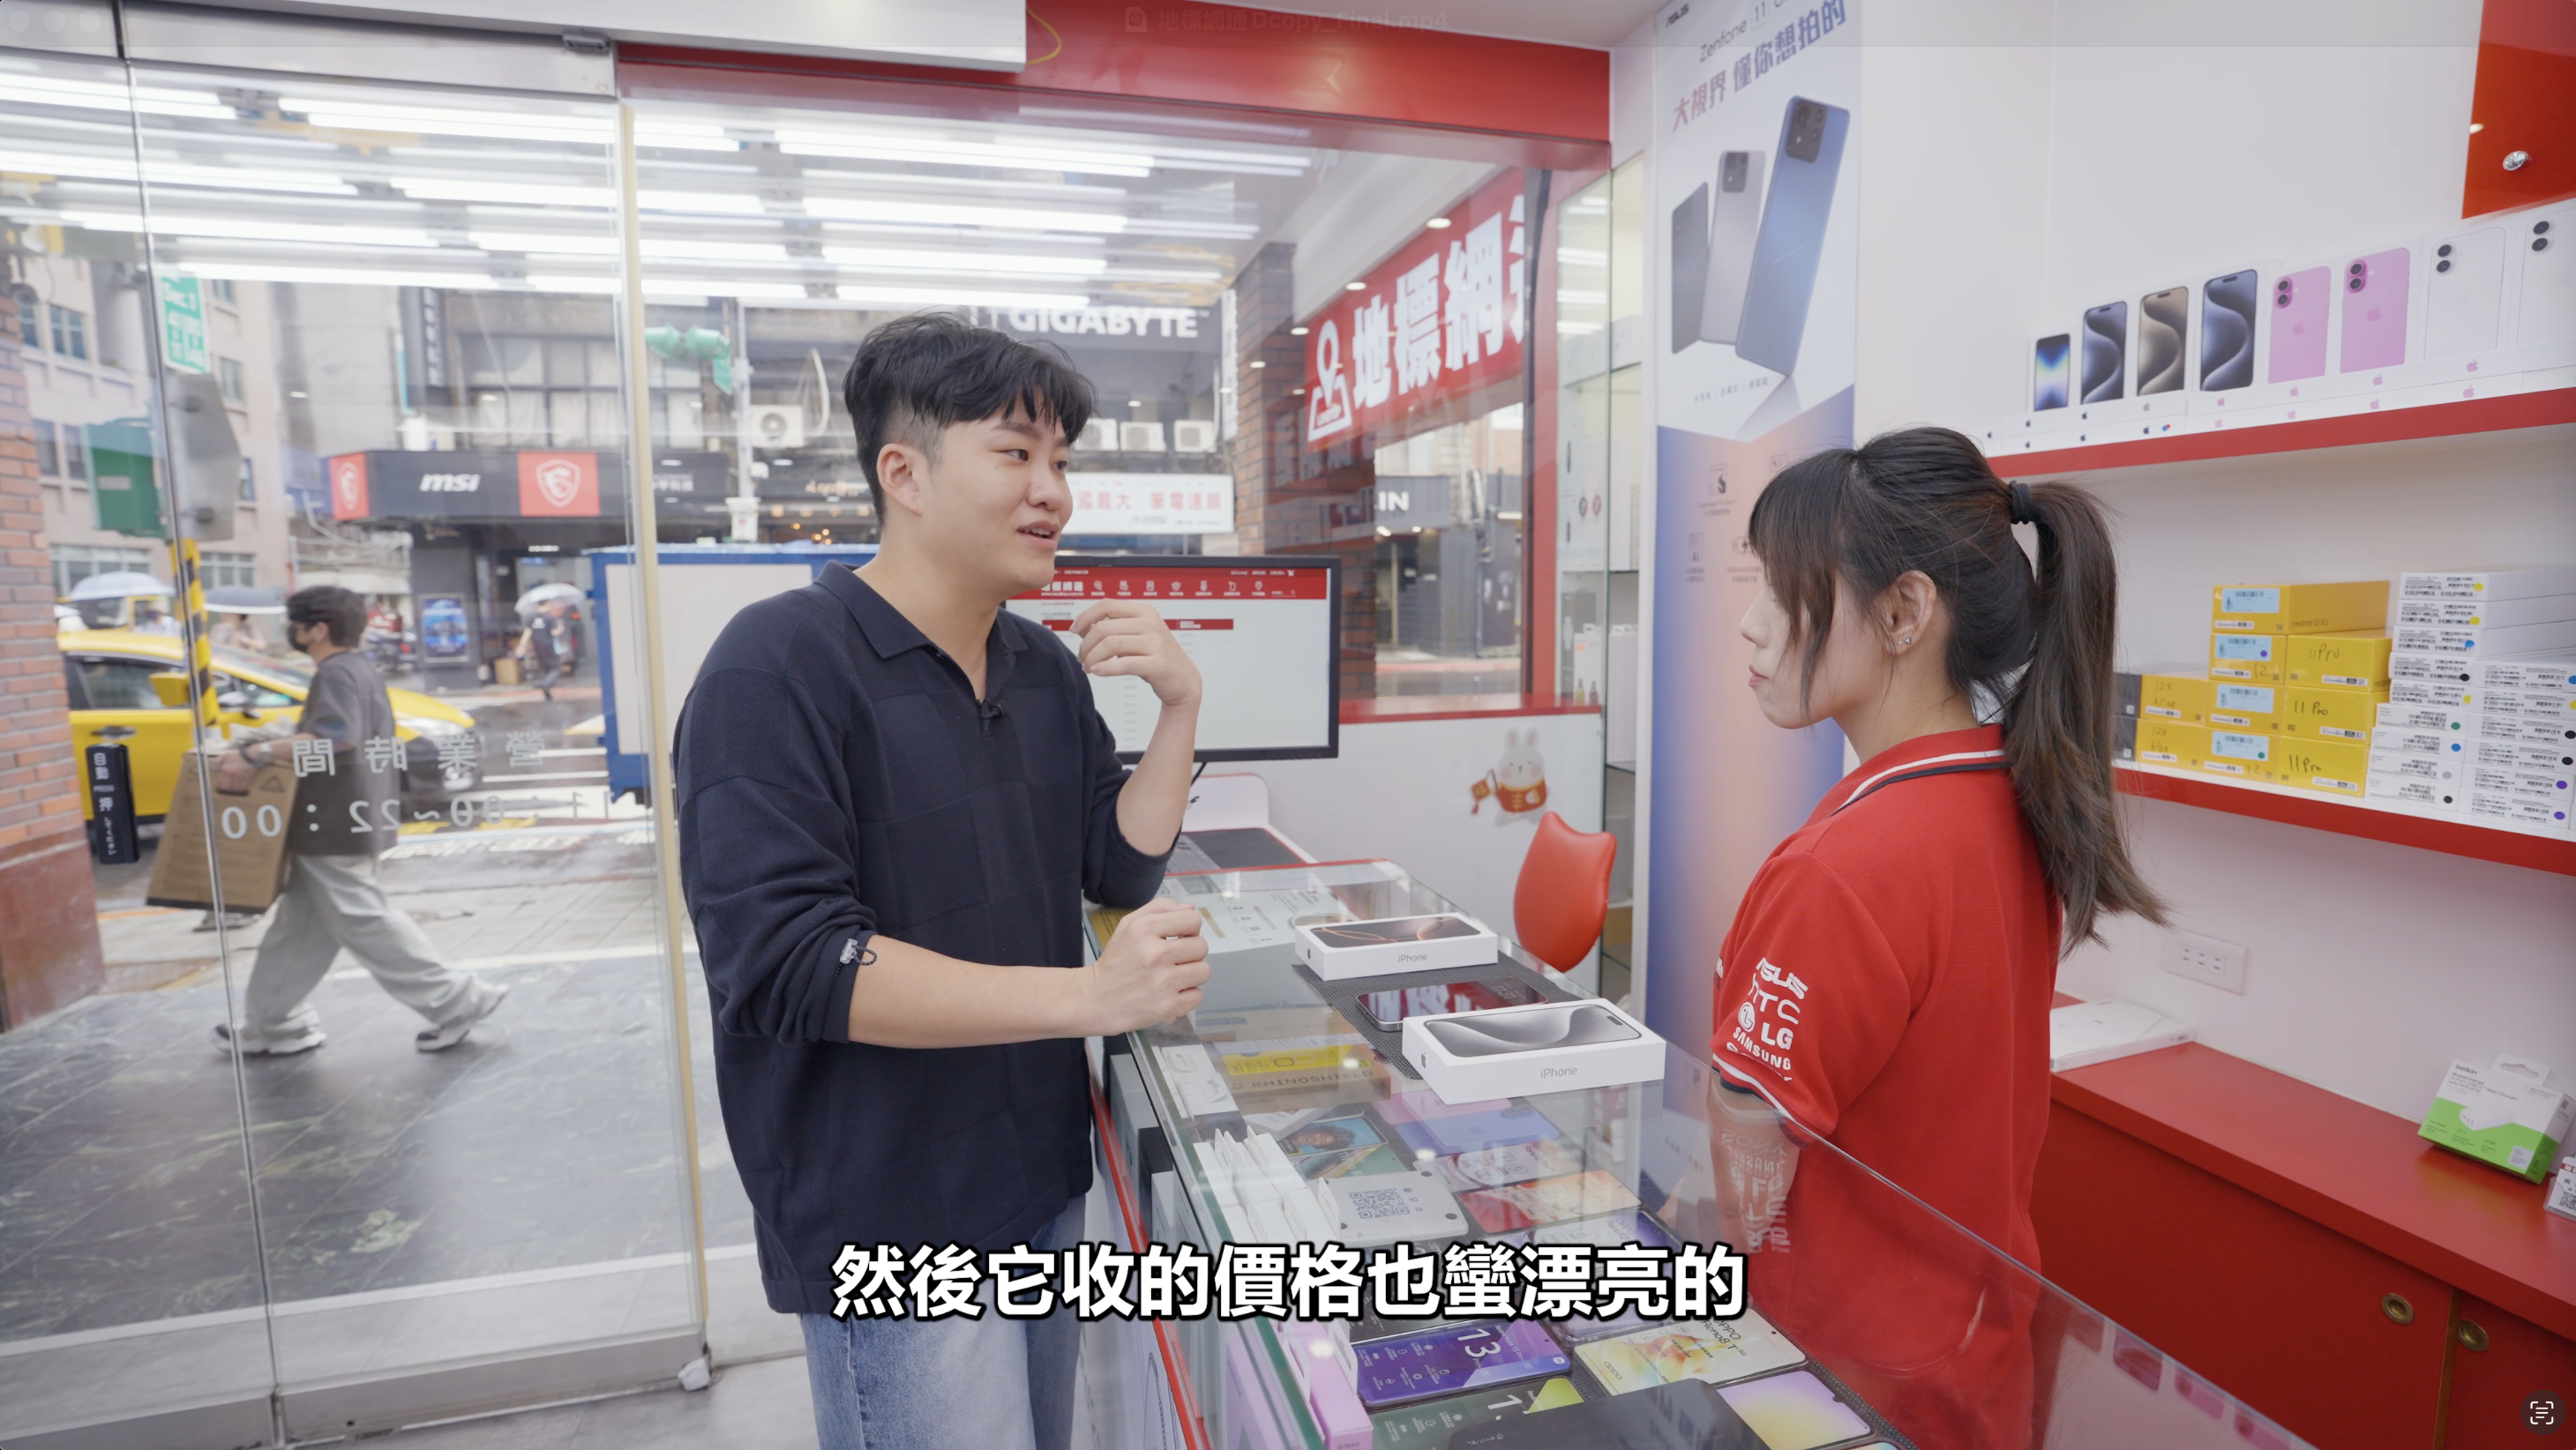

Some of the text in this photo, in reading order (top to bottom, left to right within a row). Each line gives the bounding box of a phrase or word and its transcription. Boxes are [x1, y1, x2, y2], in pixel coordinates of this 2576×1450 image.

[1699, 19, 1748, 64] Zenfone
[1672, 0, 1846, 133] 大視界 懂你想拍的
[1007, 305, 1199, 339] GIGABYTE
[419, 471, 481, 493] msi
[1397, 953, 1427, 963] iPhone
[1756, 957, 1808, 1000] ASUS
[1733, 1026, 1792, 1071] SAMSUNG
[1761, 1021, 1793, 1050] LG
[1251, 1070, 1374, 1088] RHINOSHIELD
[1540, 1066, 1578, 1079] iPhone
[2455, 1064, 2478, 1076] belkin
[1456, 1328, 1501, 1358] 13
